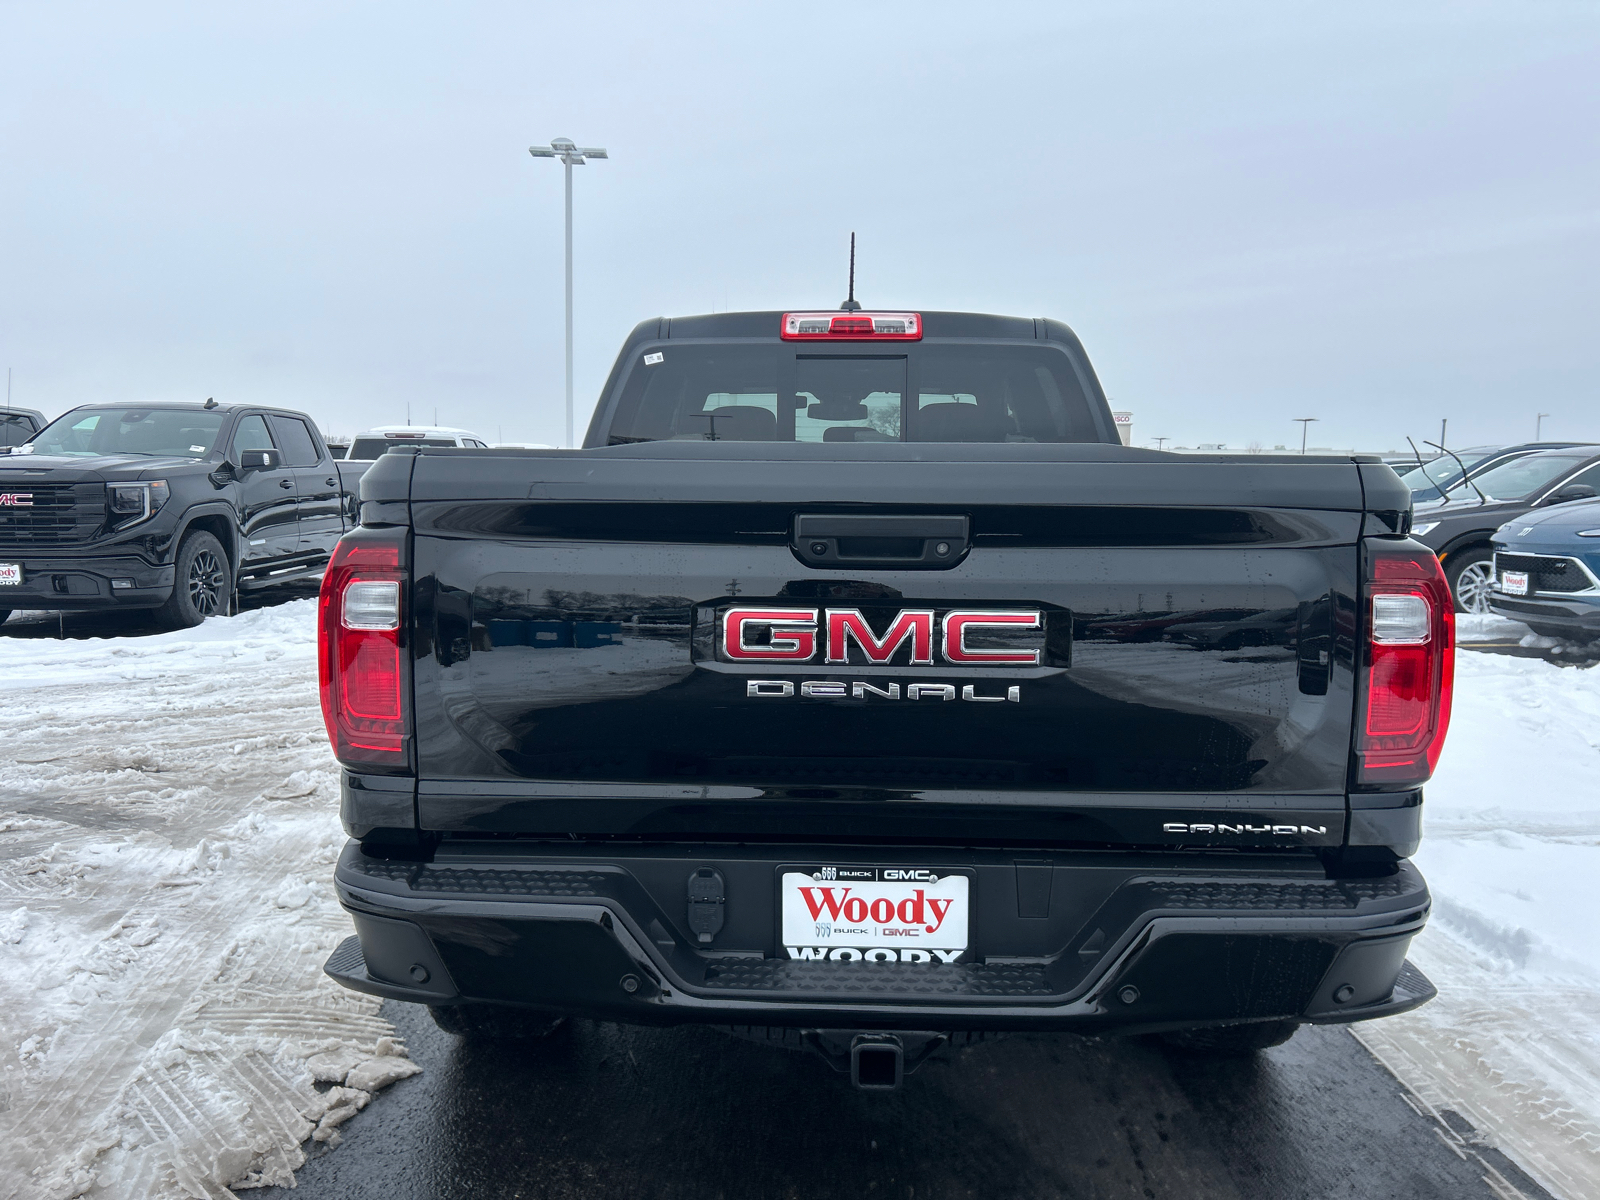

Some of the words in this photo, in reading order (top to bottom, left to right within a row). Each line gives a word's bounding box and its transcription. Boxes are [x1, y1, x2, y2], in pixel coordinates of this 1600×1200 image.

[1505, 576, 1526, 588] Woody
[722, 607, 1041, 666] GMC
[746, 680, 1020, 703] DENALI
[1163, 823, 1327, 835] CANYON
[883, 869, 930, 880] GMC
[797, 886, 954, 934] Woody
[882, 928, 920, 937] GMC
[786, 947, 965, 963] WOODY
